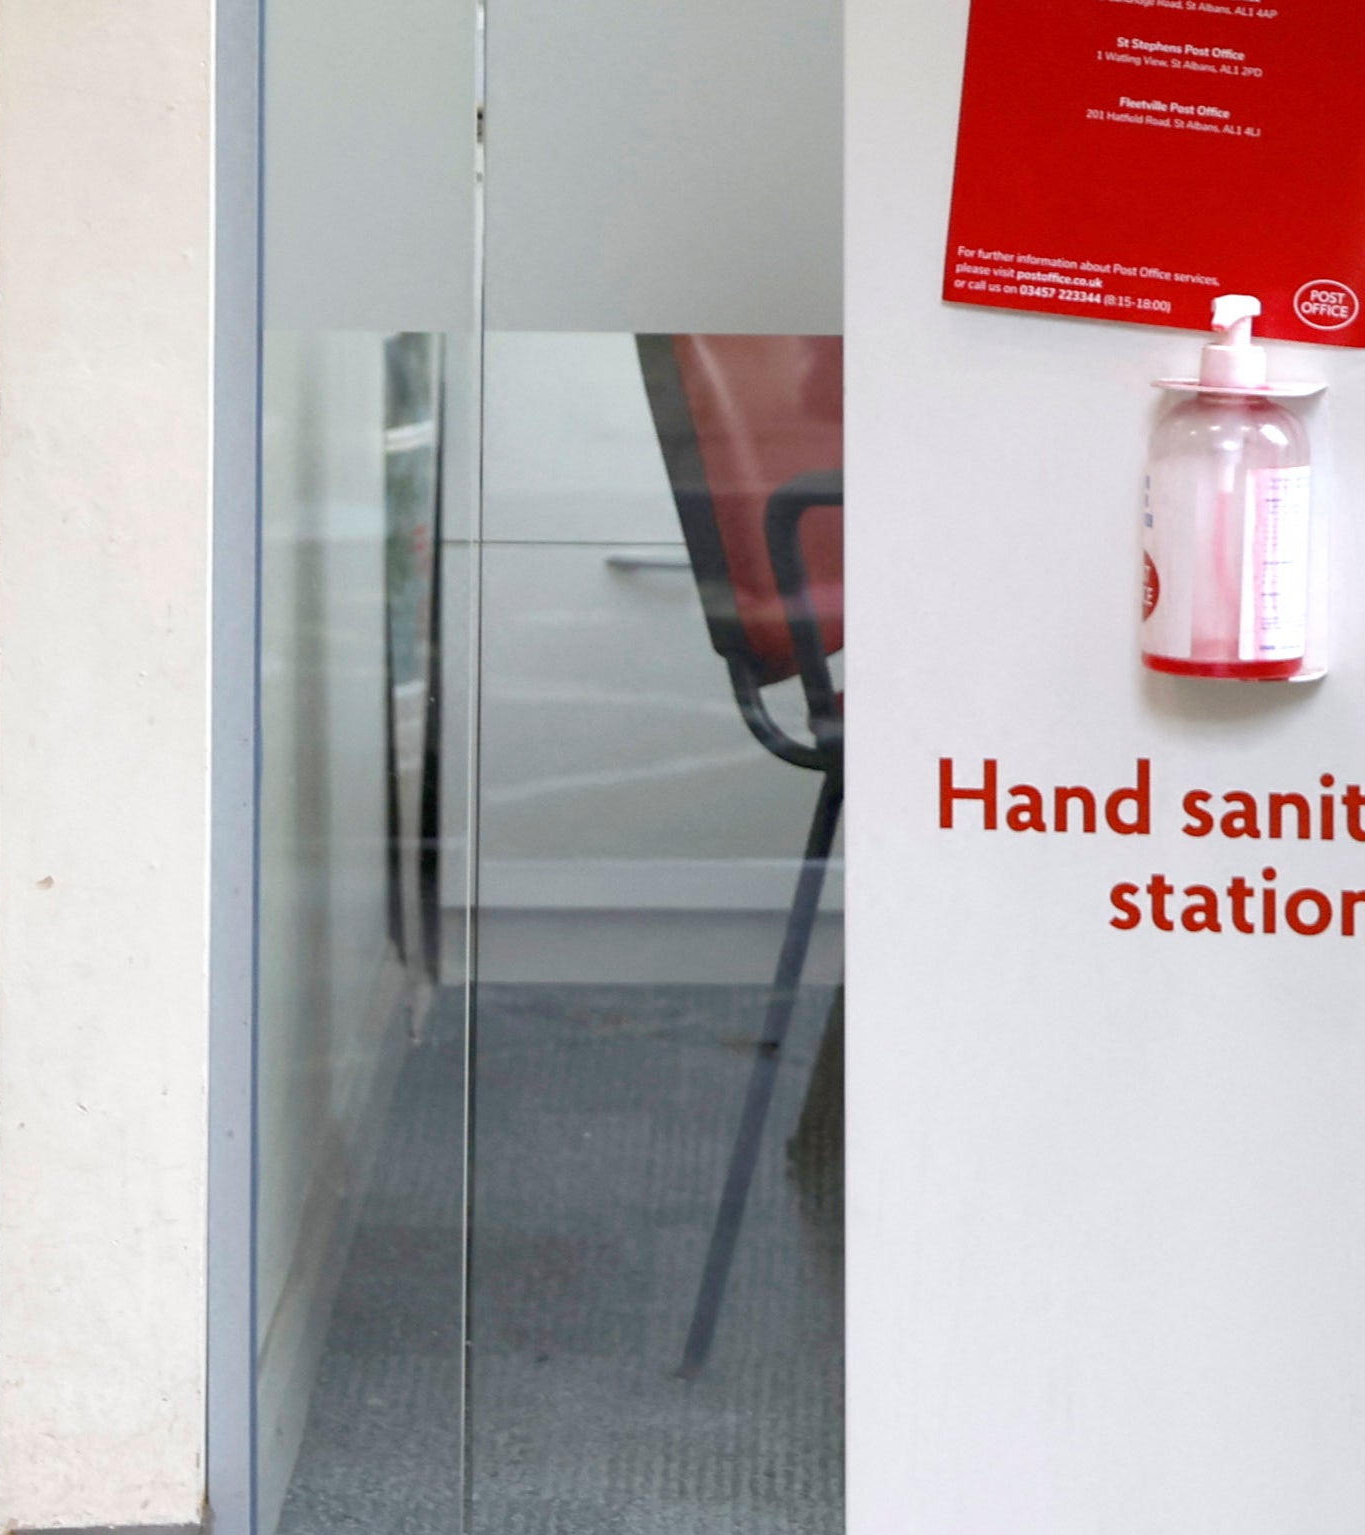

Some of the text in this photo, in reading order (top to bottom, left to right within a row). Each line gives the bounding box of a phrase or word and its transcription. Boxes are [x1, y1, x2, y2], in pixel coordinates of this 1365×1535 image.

[1185, 0, 1196, 10] St
[1117, 36, 1245, 61] St Stephens Post Office
[1170, 58, 1181, 69] St
[1086, 108, 1105, 120] 201
[1106, 111, 1144, 124] Hatfield
[1173, 118, 1184, 129] St
[1119, 96, 1231, 119] Fleetville Post Office
[957, 245, 1172, 281] For further information about Post Office
[955, 262, 1103, 288] please visit postoffice.co.uk
[954, 279, 966, 288] or
[967, 280, 987, 290] call
[988, 283, 1001, 293] us
[1003, 285, 1017, 294] on
[1019, 284, 1056, 299] 03457
[1058, 288, 1101, 304] 223344
[1310, 289, 1346, 304] POST
[1300, 301, 1349, 318] OFFICE
[938, 757, 1151, 835] Hand
